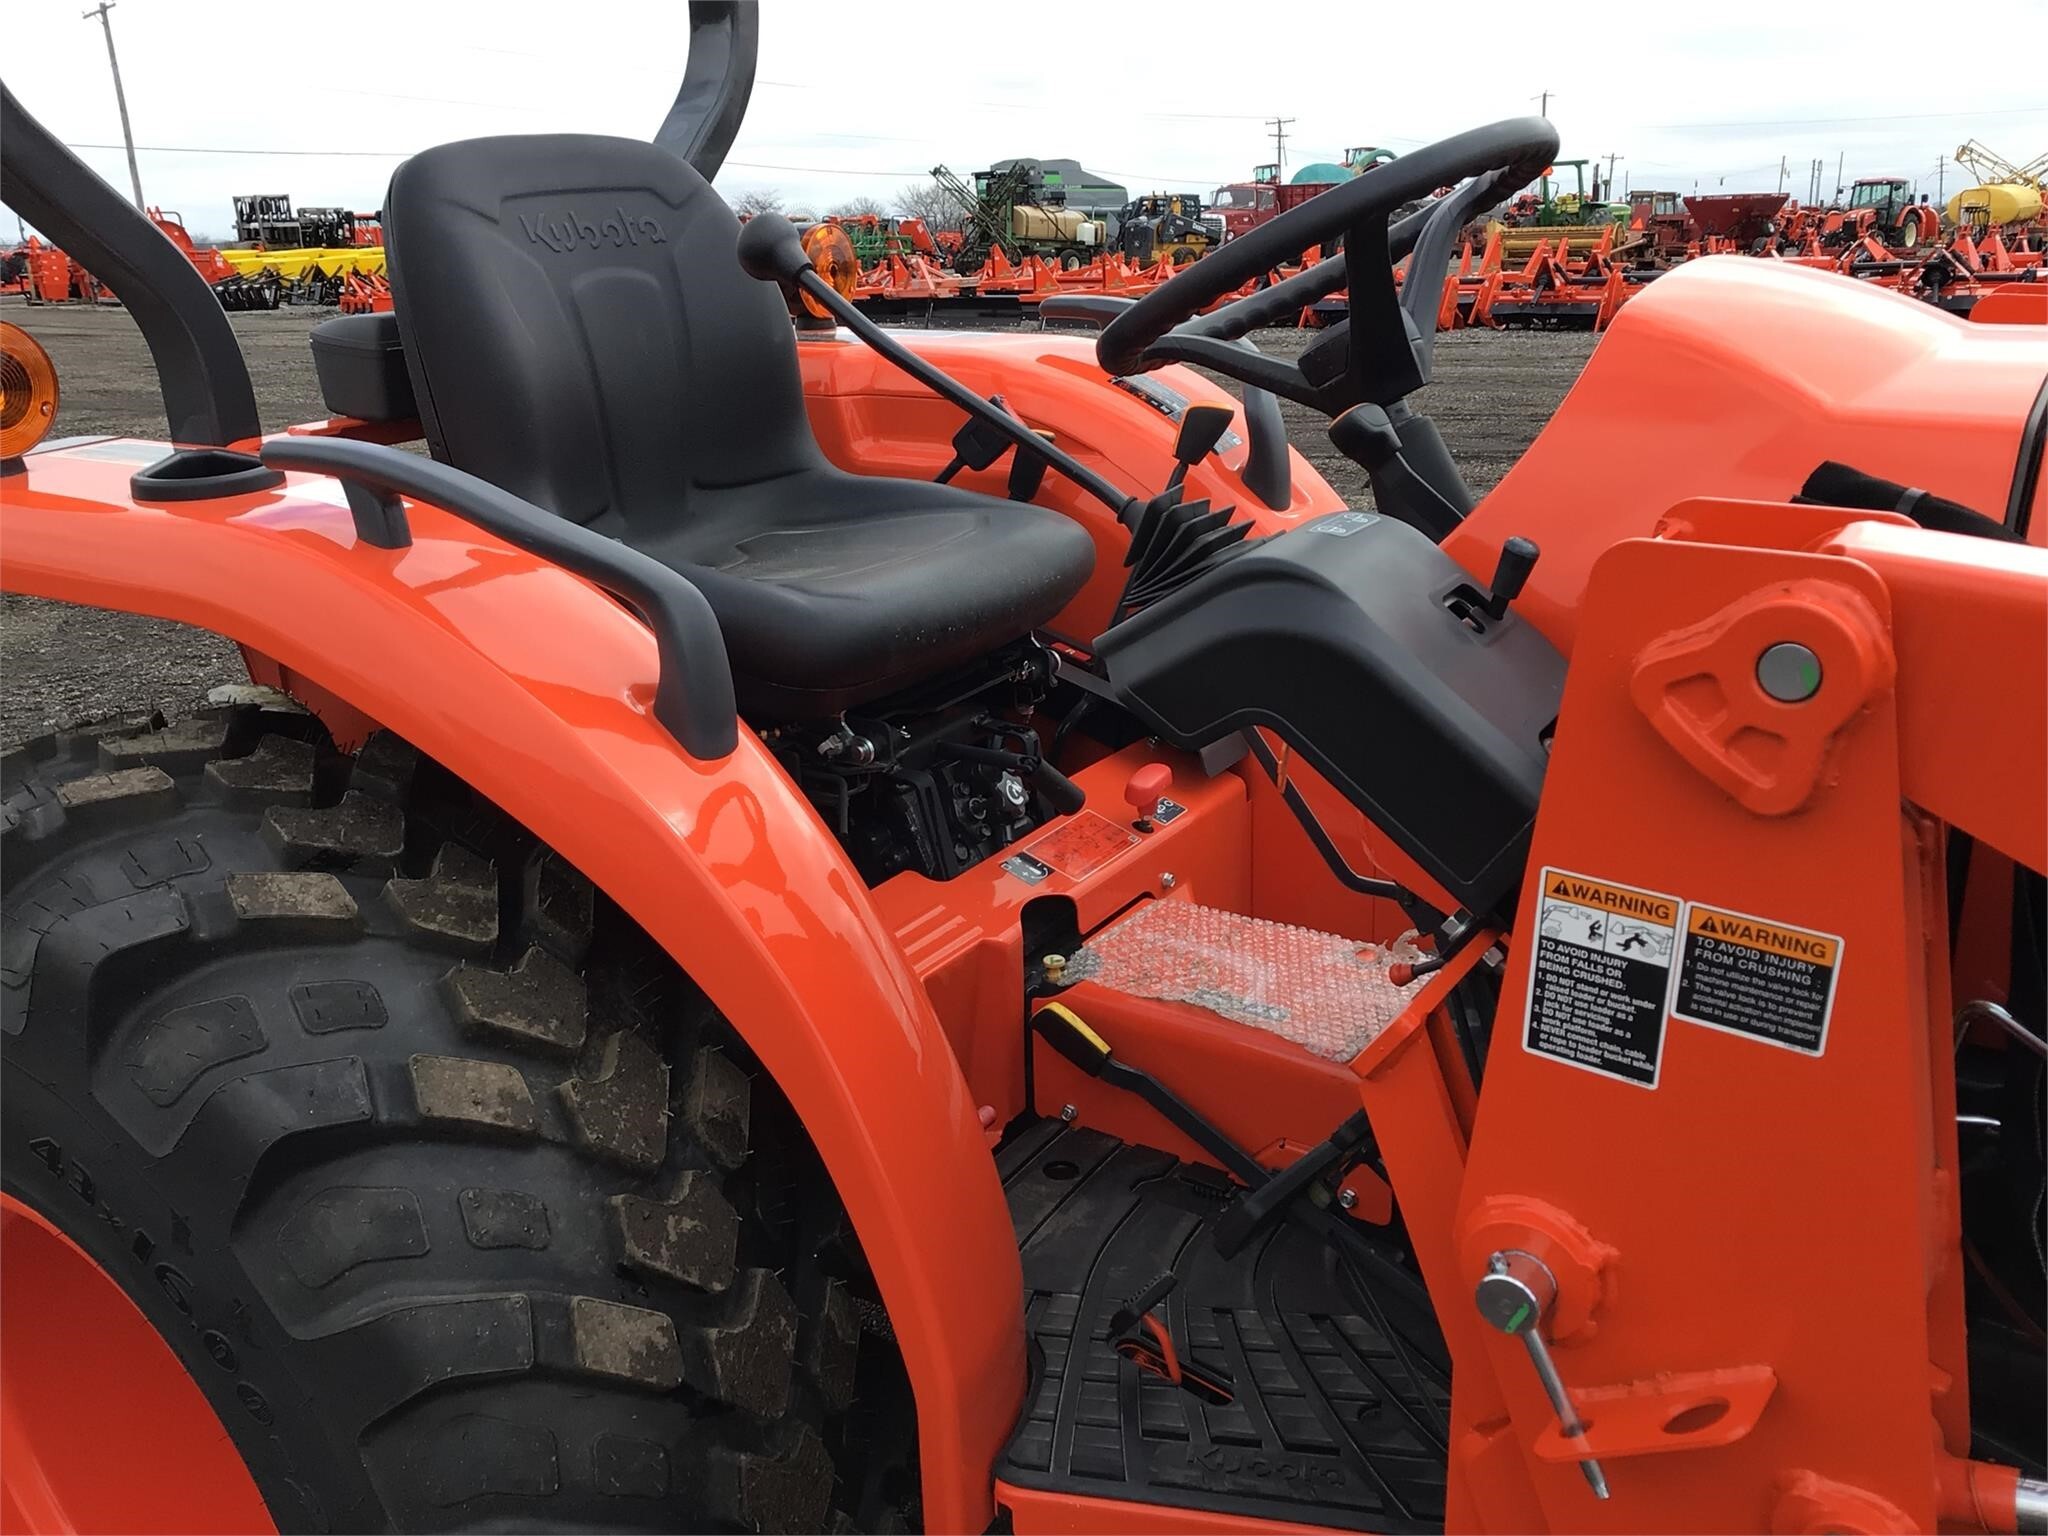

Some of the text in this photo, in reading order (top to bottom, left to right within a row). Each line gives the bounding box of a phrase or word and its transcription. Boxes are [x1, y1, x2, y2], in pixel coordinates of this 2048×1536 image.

[519, 207, 668, 253] Kubota
[1572, 882, 1670, 920] WARNING
[1541, 940, 1628, 969] TO AVOID INJURY
[1697, 936, 1816, 973] TO AVOID INJURY
[1720, 919, 1826, 959] WARNING
[1538, 960, 1627, 990] BEING CRUSHED:
[1540, 950, 1622, 978] FROM FALLS OR
[1695, 948, 1734, 965] FROM
[1738, 959, 1811, 985] CRUSHING
[1697, 962, 1709, 971] Do
[1710, 966, 1725, 975] not
[1726, 970, 1751, 982] utilize
[1752, 977, 1766, 986] the
[1767, 981, 1791, 993] valve
[1811, 991, 1824, 1001] for
[1544, 990, 1556, 1000] DO
[1557, 994, 1573, 1004] NOT
[1574, 1000, 1589, 1009] use
[1590, 1003, 1615, 1016] loader
[1616, 1011, 1626, 1019] as
[1545, 983, 1570, 995] raised
[1570, 990, 1595, 1001] loader
[1546, 973, 1558, 983] DO
[1559, 977, 1575, 987] NOT
[1576, 982, 1599, 994] stand
[1610, 992, 1630, 1002] work
[1632, 998, 1656, 1009] under
[1695, 973, 1730, 987] machine
[1785, 996, 1795, 1004] or
[1695, 982, 1711, 993] The
[1713, 988, 1737, 999] valve
[1738, 994, 1756, 1005] lock
[1768, 1002, 1777, 1010] to
[1778, 1006, 1814, 1020] prevent
[1542, 1016, 1561, 1026] work
[1542, 1007, 1554, 1017] DO
[1555, 1010, 1571, 1021] NOT
[1572, 1017, 1587, 1025] use
[1588, 1020, 1613, 1033] loader
[1614, 1028, 1624, 1036] as
[1561, 1003, 1573, 1012] for
[1699, 1004, 1713, 1014] not
[1714, 1008, 1722, 1016] in
[1723, 1012, 1739, 1020] use
[1750, 1019, 1777, 1033] during
[1540, 1023, 1565, 1036] NEVER
[1567, 1032, 1598, 1046] connect
[1624, 1049, 1647, 1060] cable
[1549, 1036, 1567, 1046] rope
[1568, 1040, 1577, 1048] to
[1578, 1043, 1602, 1056] loader
[1603, 1050, 1631, 1064] bucket
[1632, 1060, 1655, 1071] while
[1187, 1447, 1346, 1487] Kubota
